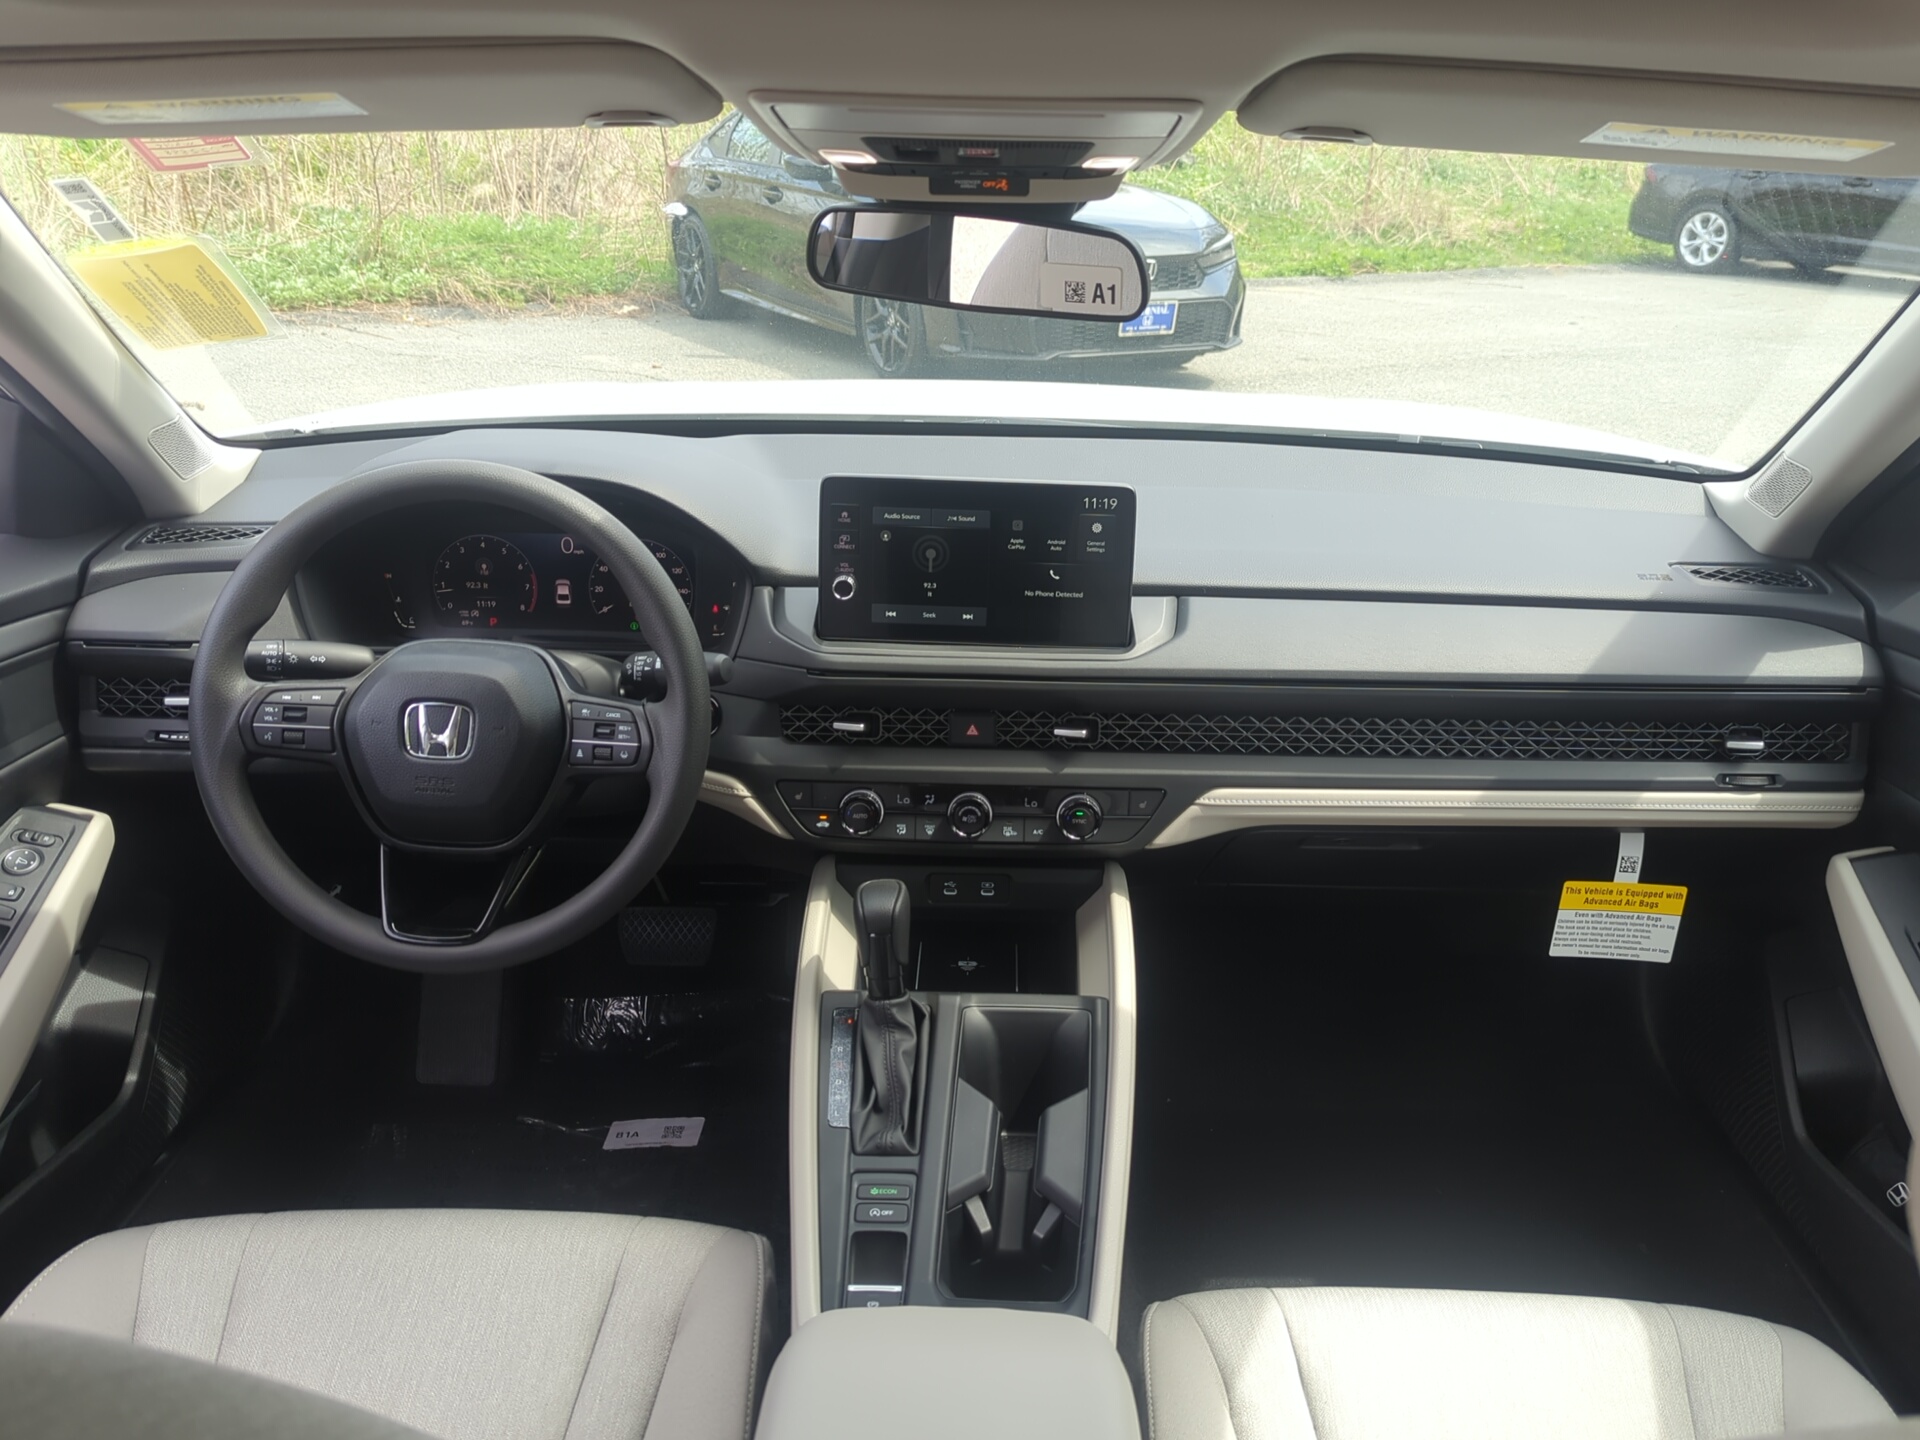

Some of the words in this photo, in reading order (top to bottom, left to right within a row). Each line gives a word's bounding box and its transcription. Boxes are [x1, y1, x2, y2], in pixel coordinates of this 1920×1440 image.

[1092, 282, 1116, 304] A1
[1083, 498, 1118, 510] 11:19
[560, 536, 574, 554] 0
[1565, 886, 1582, 894] This
[1584, 887, 1614, 896] Vehicle
[1626, 888, 1664, 899] Equipped
[1666, 892, 1684, 900] with
[1583, 897, 1623, 906] Advanced
[1639, 900, 1659, 909] Bags
